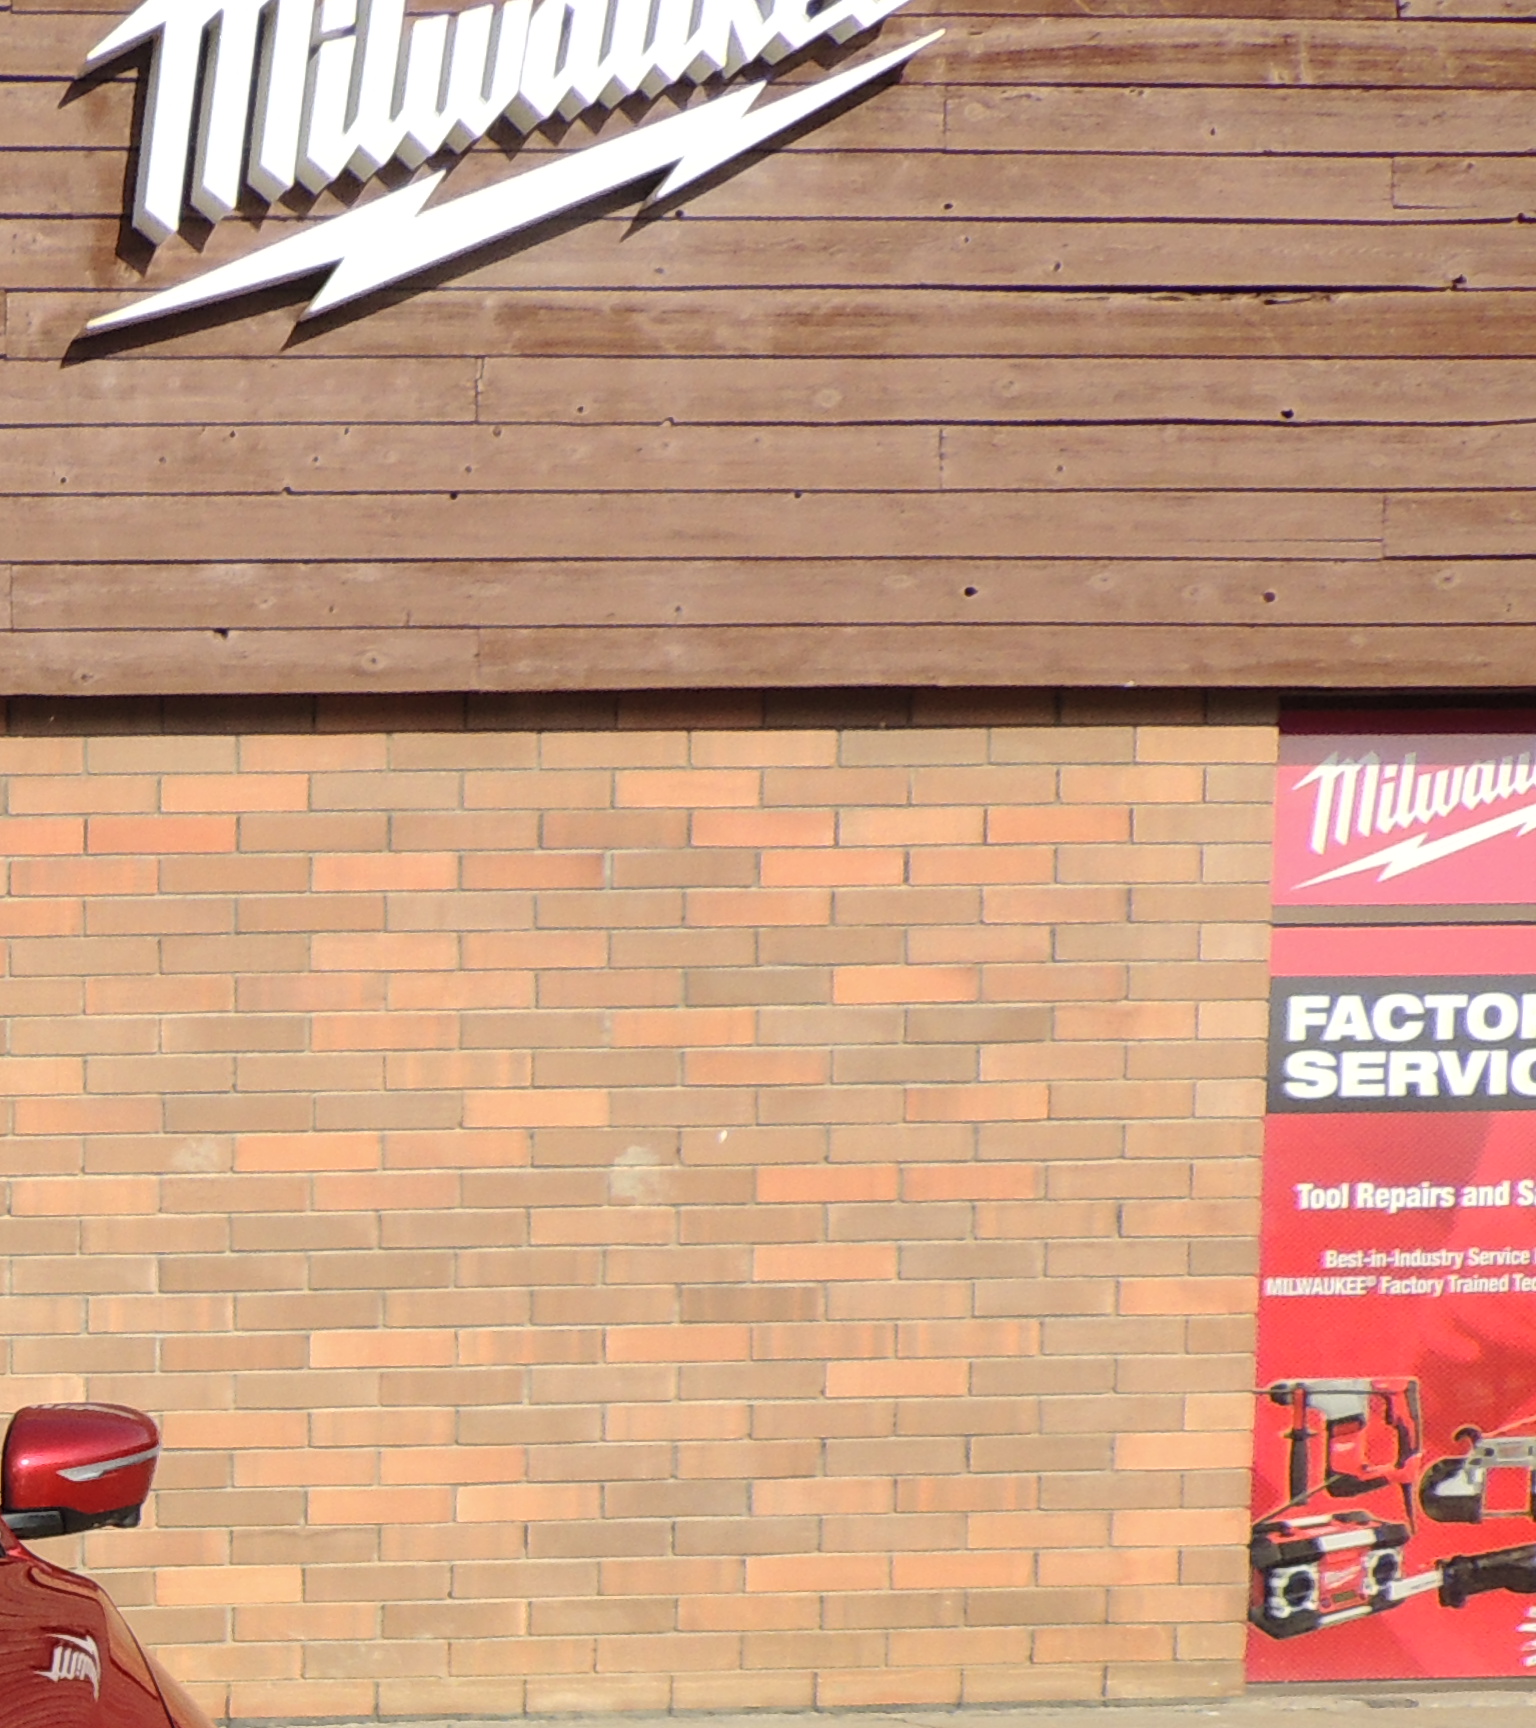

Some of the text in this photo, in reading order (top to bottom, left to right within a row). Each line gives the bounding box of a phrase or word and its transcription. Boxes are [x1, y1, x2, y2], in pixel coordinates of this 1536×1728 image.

[86, 0, 912, 246] Milwauk
[1291, 749, 1536, 855] Milwau
[1296, 1183, 1349, 1210] Tool
[1356, 1181, 1455, 1214] Repairs
[1461, 1181, 1510, 1208] and
[1324, 1248, 1465, 1269] Best-in-Industry
[1468, 1247, 1530, 1266] Service
[1380, 1275, 1445, 1297] Factory
[1449, 1273, 1509, 1294] Trained
